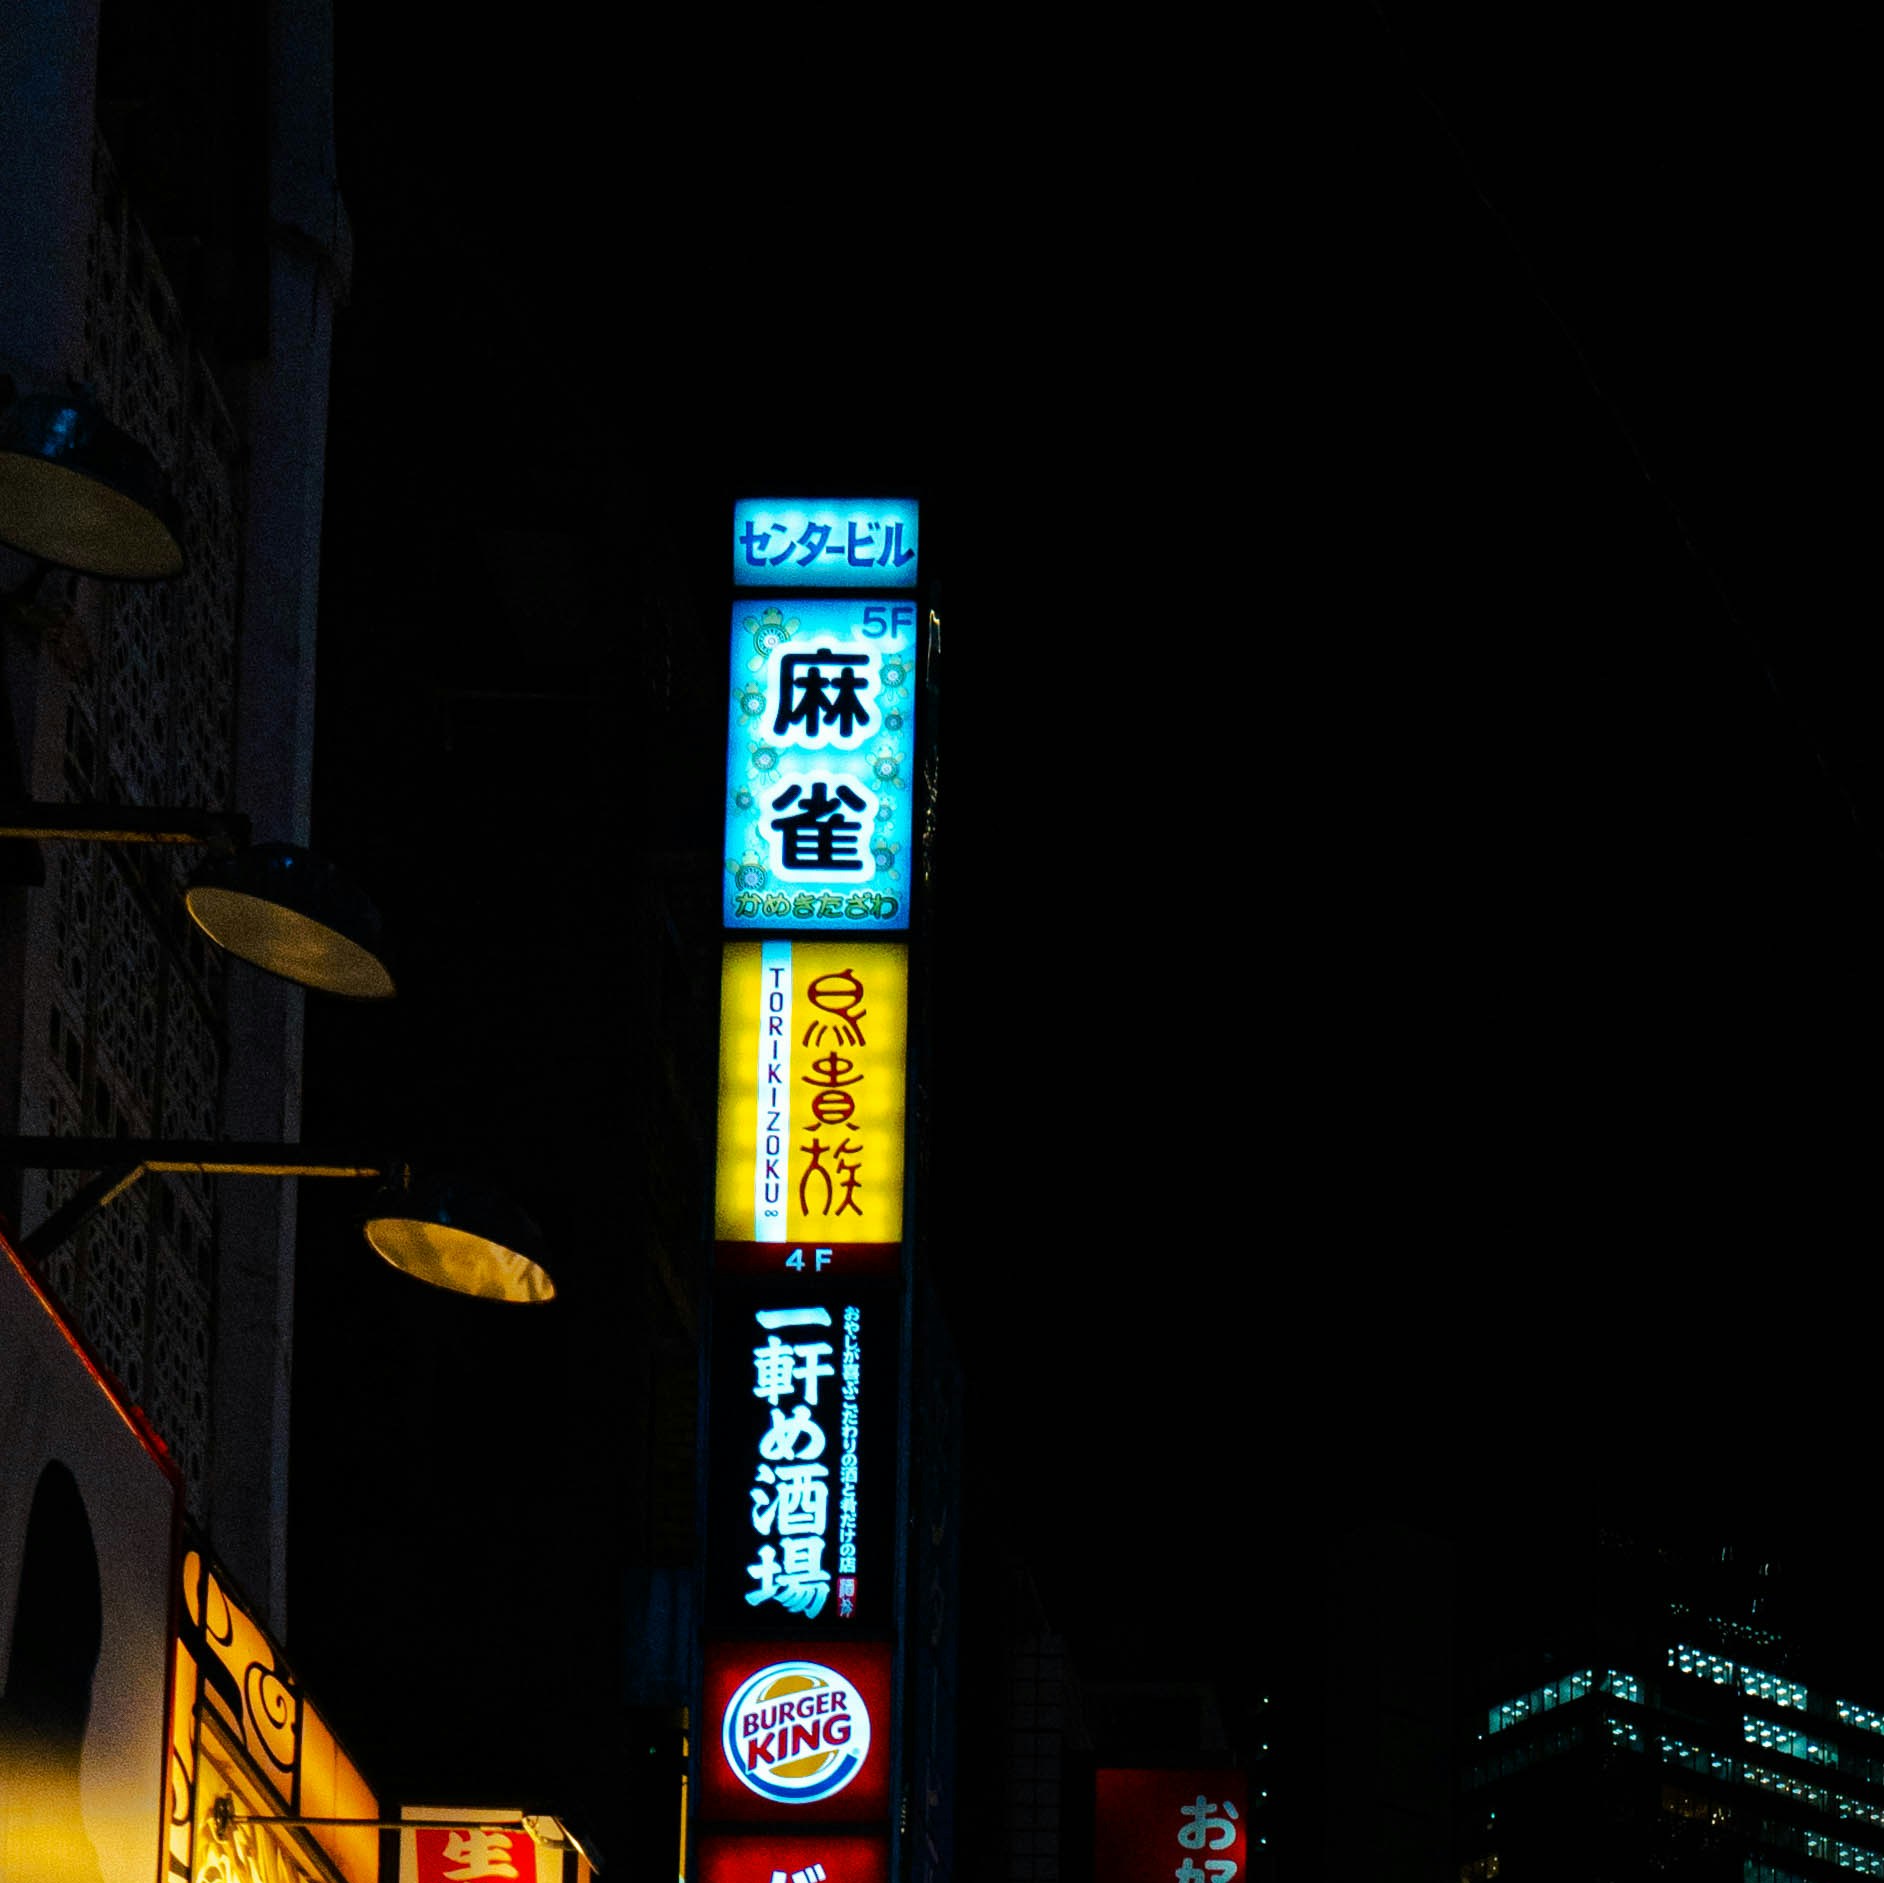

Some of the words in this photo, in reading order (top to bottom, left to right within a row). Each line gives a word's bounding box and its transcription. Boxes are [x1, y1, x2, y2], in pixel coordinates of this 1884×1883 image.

[738, 520, 915, 568] センタービル
[861, 606, 912, 640] 5F
[770, 648, 870, 872] 麻雀
[763, 967, 787, 1204] TORIKIZOKU
[799, 968, 868, 1217] 鳥貴族
[745, 1306, 834, 1620] 一軒め酒場
[742, 1690, 847, 1738] BURGER
[746, 1709, 853, 1773] KING
